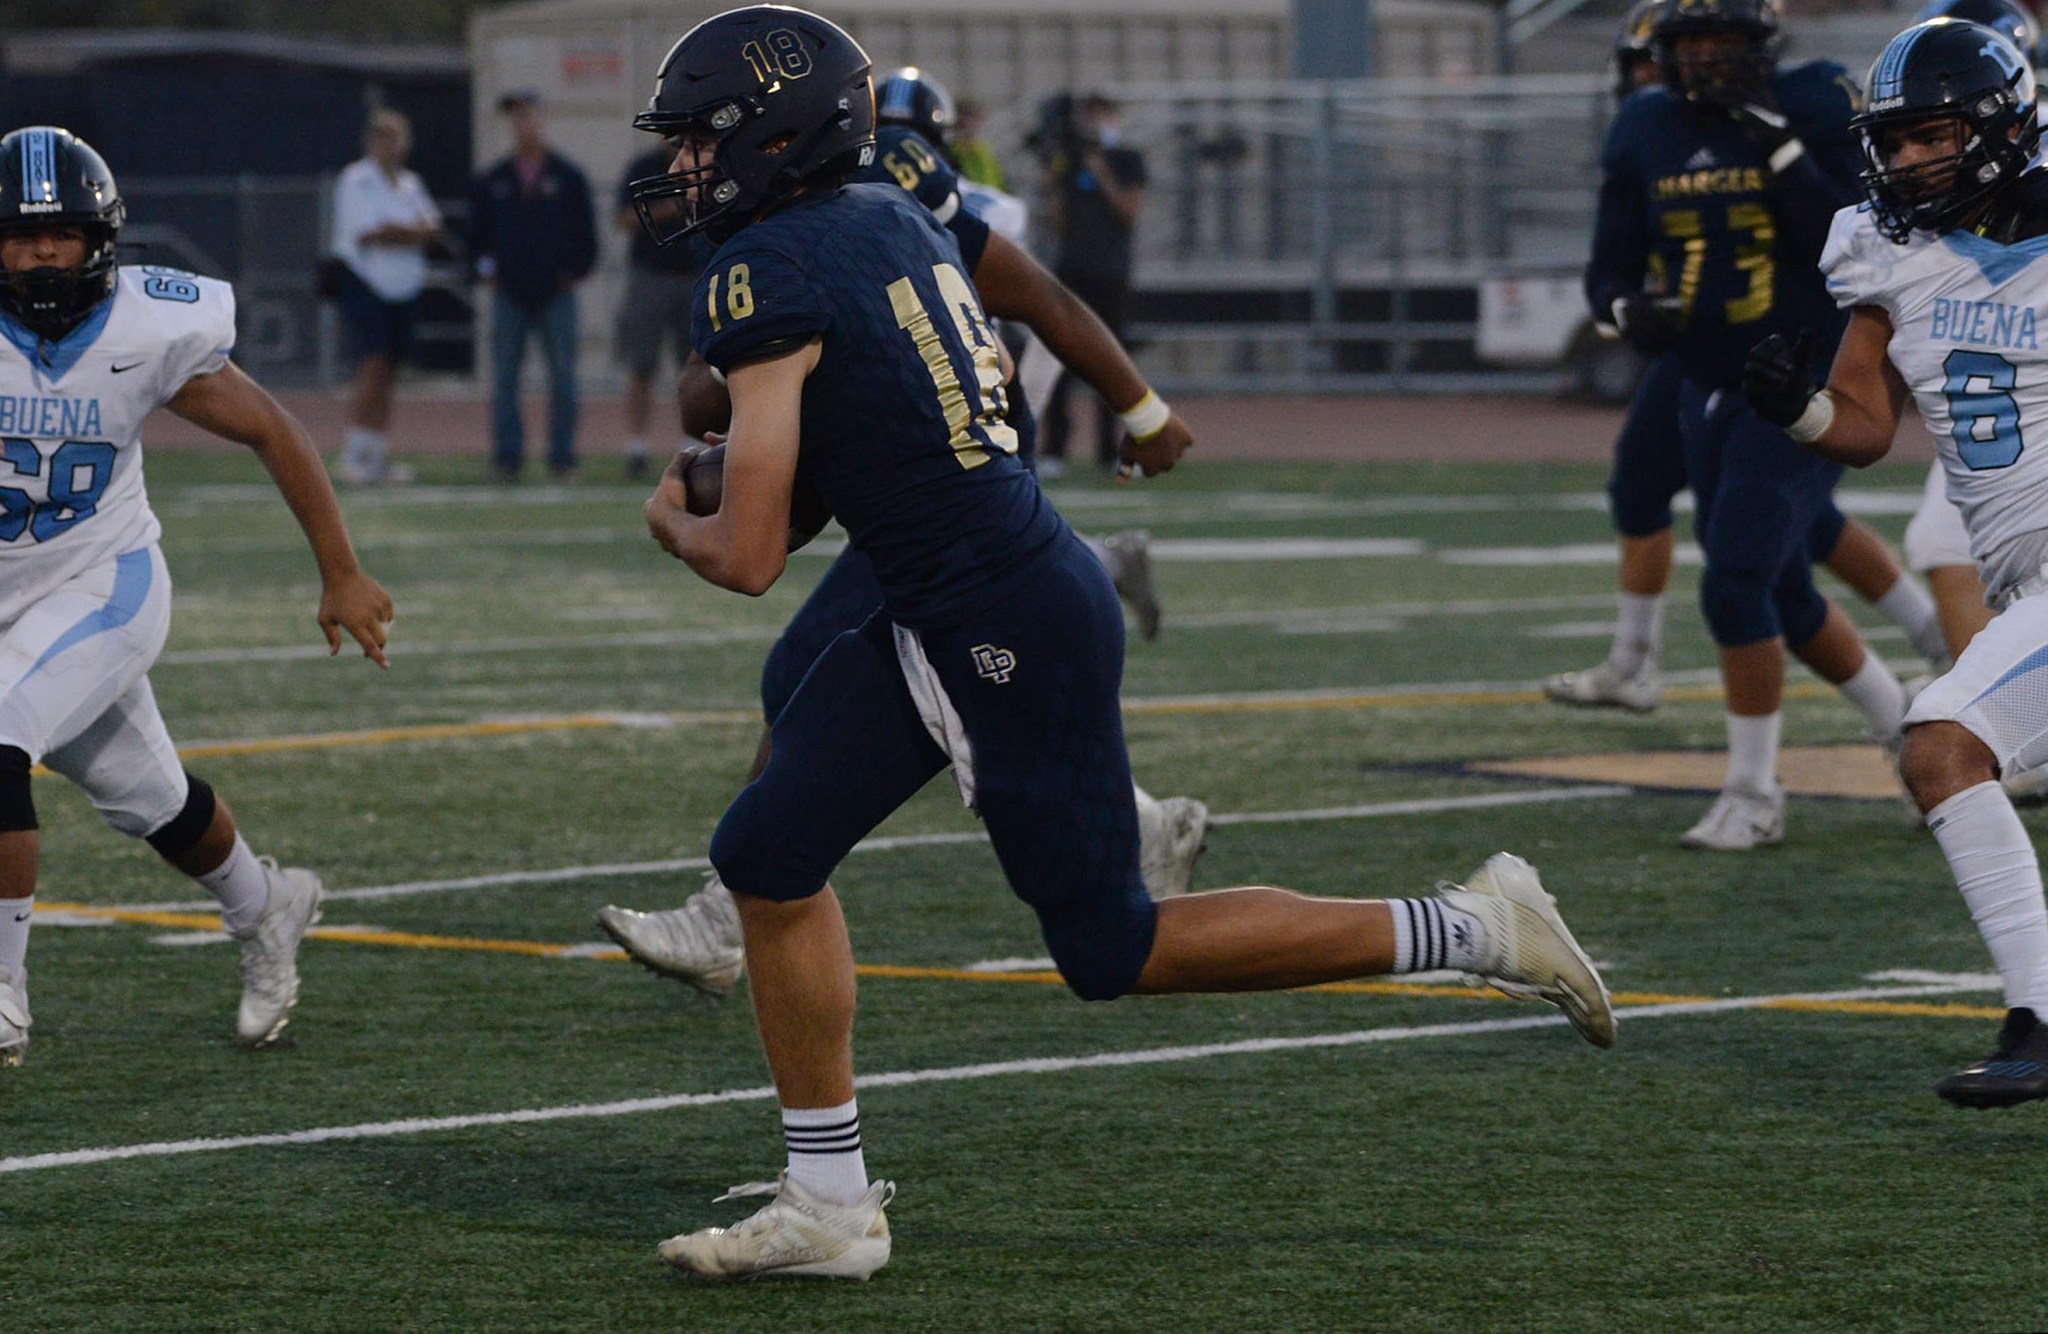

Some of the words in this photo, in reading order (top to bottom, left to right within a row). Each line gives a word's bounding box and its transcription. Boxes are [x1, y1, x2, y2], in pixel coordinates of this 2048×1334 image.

[742, 28, 813, 83] 18
[708, 262, 754, 333] 18
[1660, 203, 1775, 325] 73
[886, 263, 1019, 471] 18
[1930, 298, 2039, 350] BUENA
[0, 396, 102, 436] BUENA
[1942, 348, 2024, 472] 6
[0, 437, 118, 543] 68
